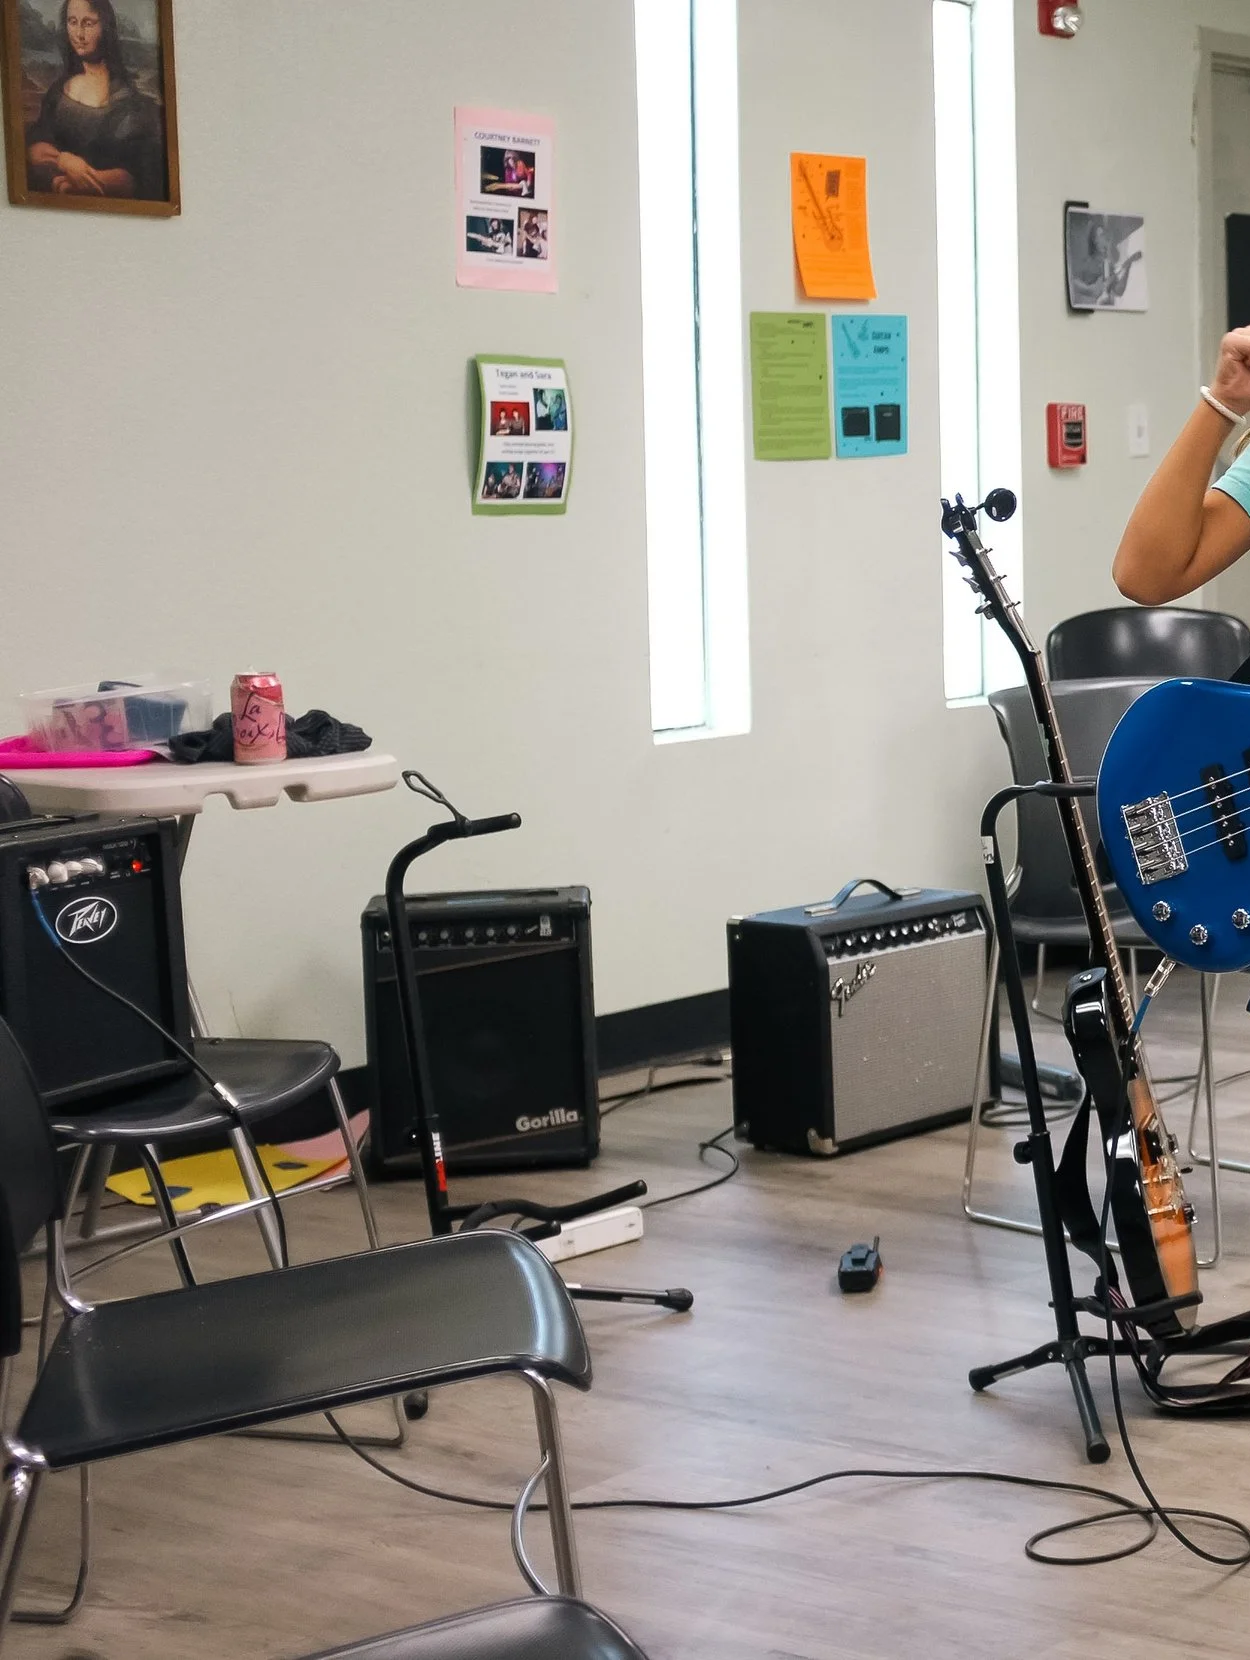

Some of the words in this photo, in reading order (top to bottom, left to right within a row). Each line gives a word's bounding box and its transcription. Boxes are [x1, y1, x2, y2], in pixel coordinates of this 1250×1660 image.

[1060, 405, 1083, 420] FIRE
[240, 691, 261, 723] La
[67, 900, 108, 938] PEAVEY
[515, 1106, 579, 1133] Gorilla
